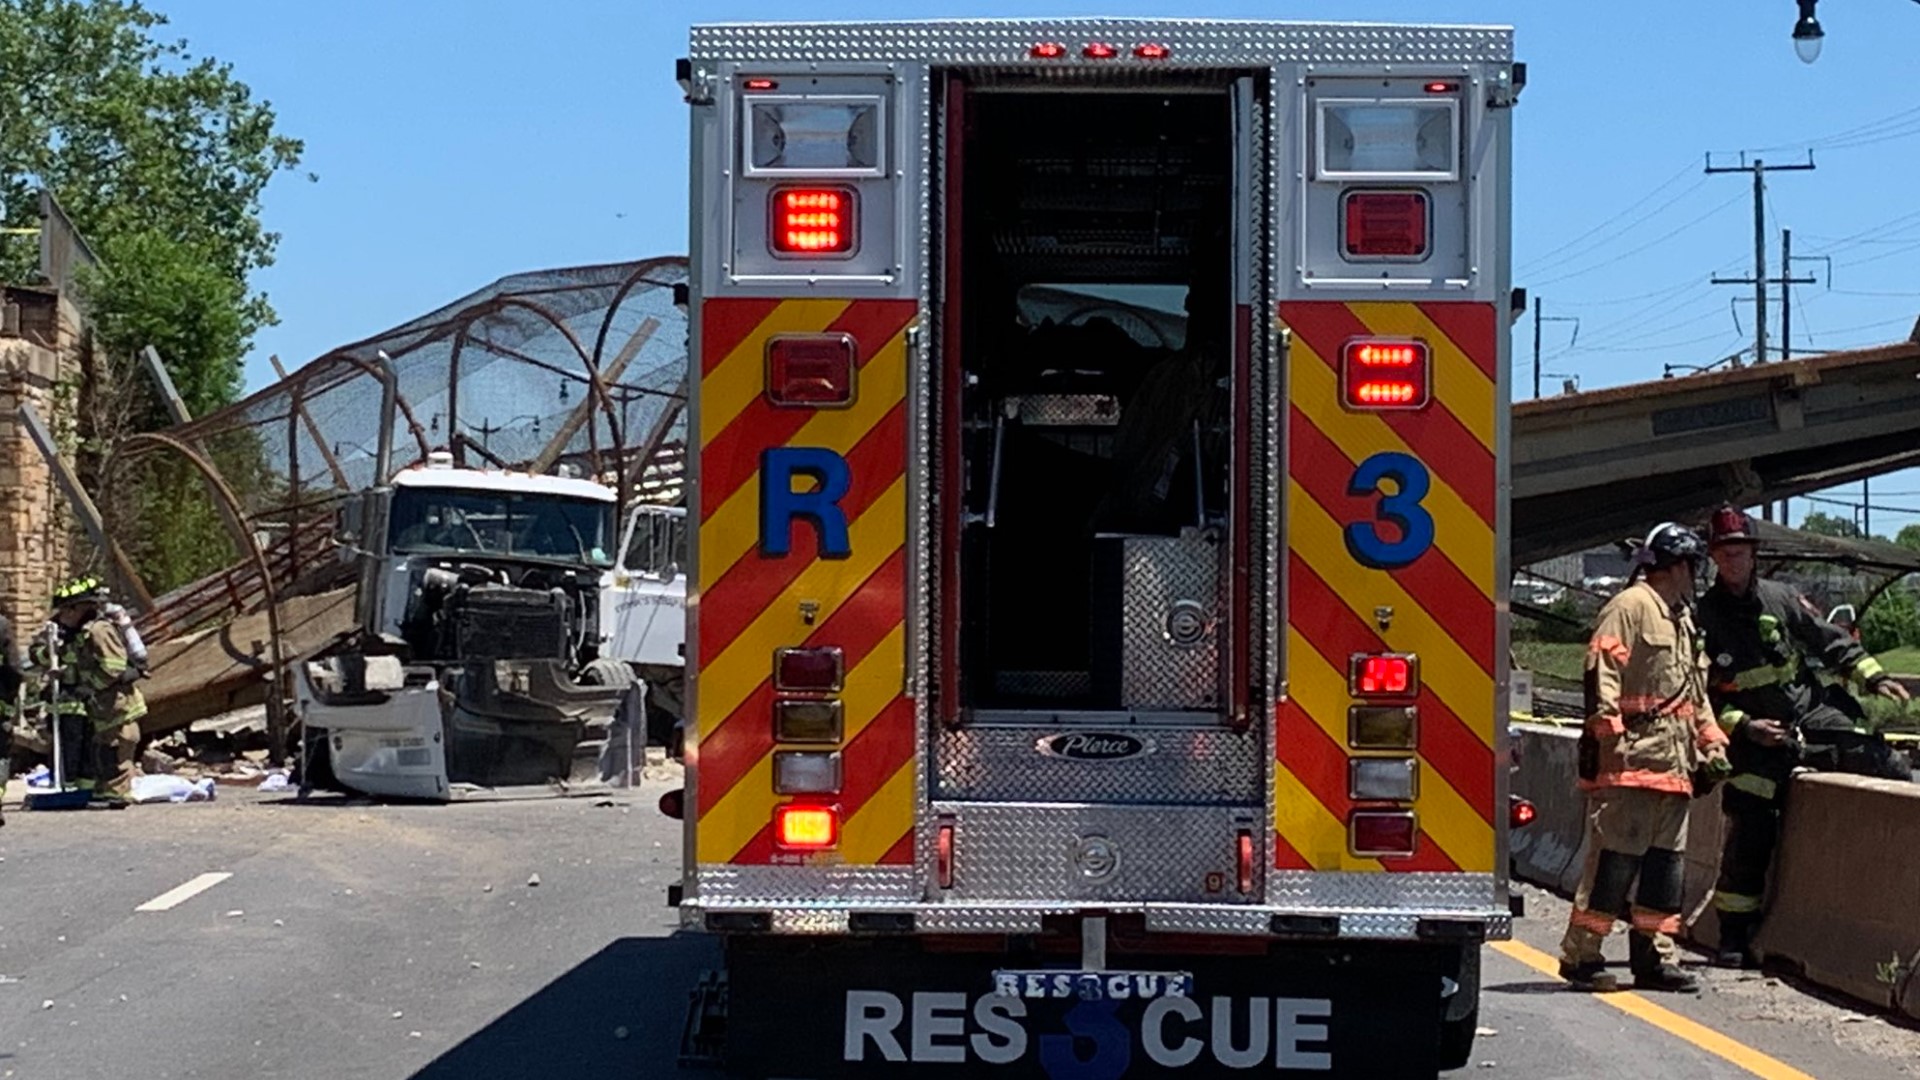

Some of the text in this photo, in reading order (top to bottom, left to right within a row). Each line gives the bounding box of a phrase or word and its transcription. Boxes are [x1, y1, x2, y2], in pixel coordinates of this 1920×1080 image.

[759, 447, 851, 560] R
[1344, 451, 1434, 569] 3
[1062, 734, 1130, 755] Pierce
